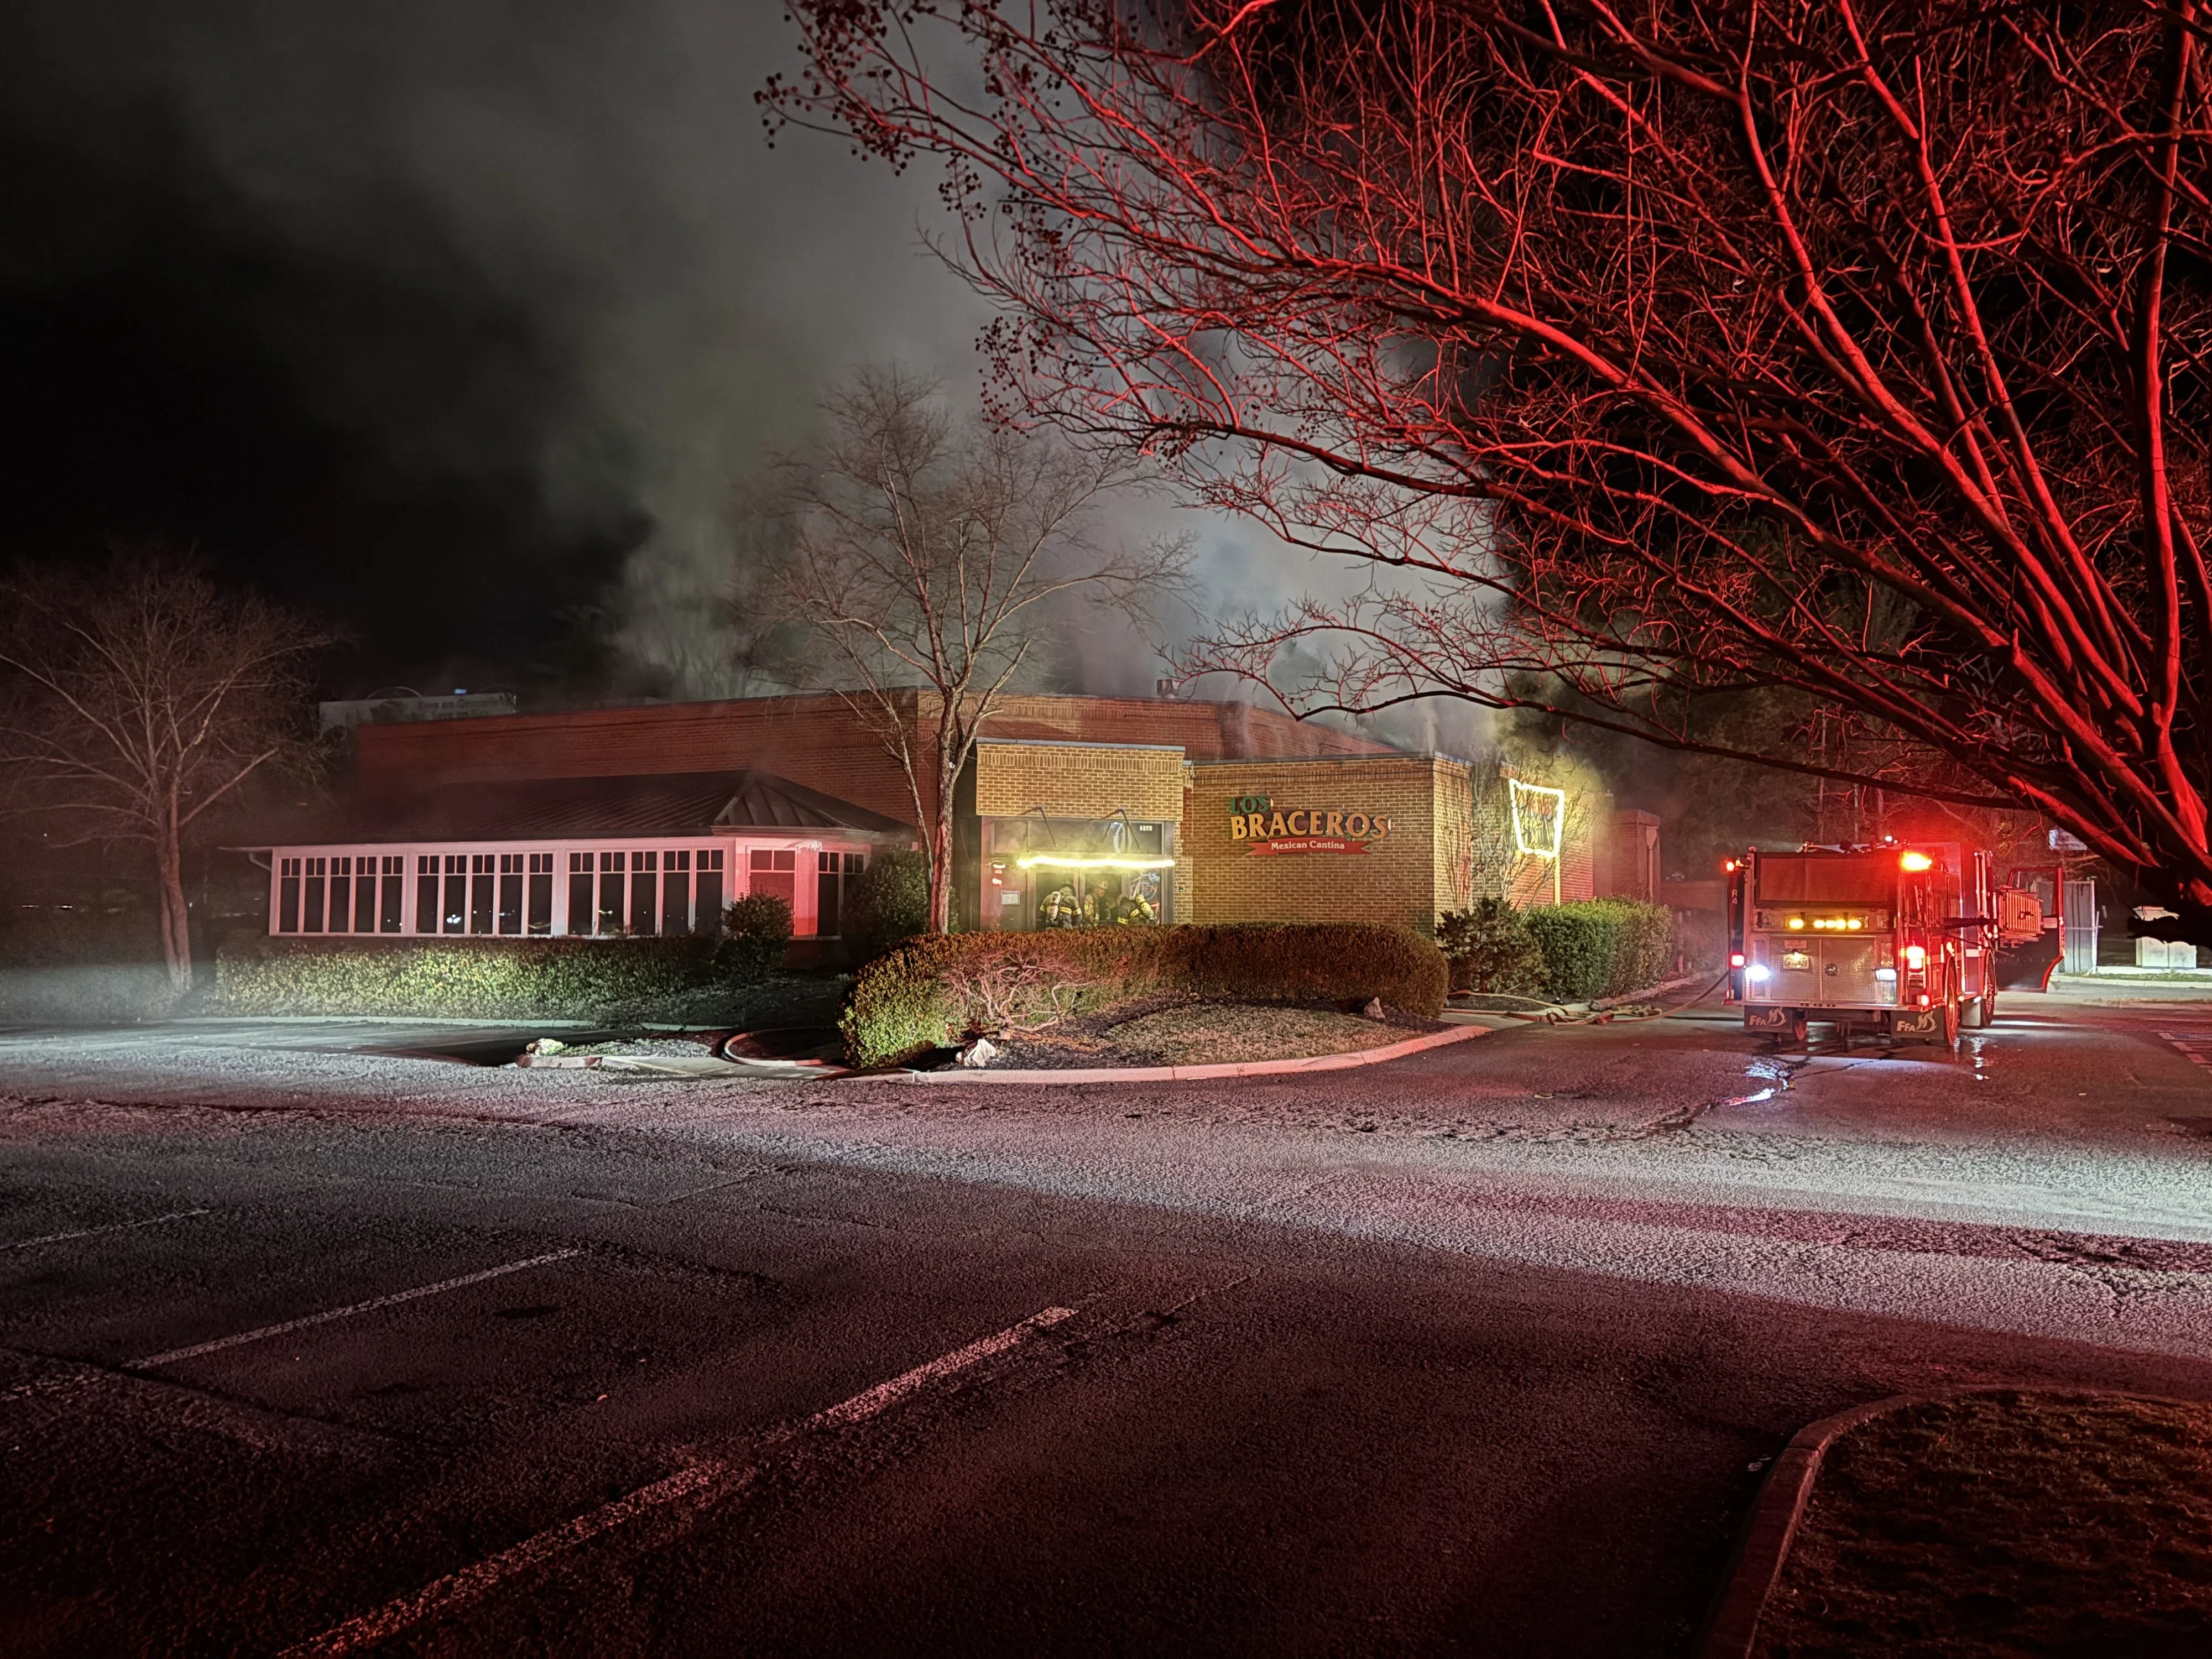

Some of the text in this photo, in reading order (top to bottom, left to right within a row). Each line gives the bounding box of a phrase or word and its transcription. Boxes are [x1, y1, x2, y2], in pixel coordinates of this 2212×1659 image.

[1230, 796, 1270, 814] LOS
[1230, 811, 1390, 839] BRACEROS
[1310, 840, 1345, 849] Cantina
[1749, 1015, 1766, 1026] FFA
[1897, 1020, 1916, 1032] FFA
